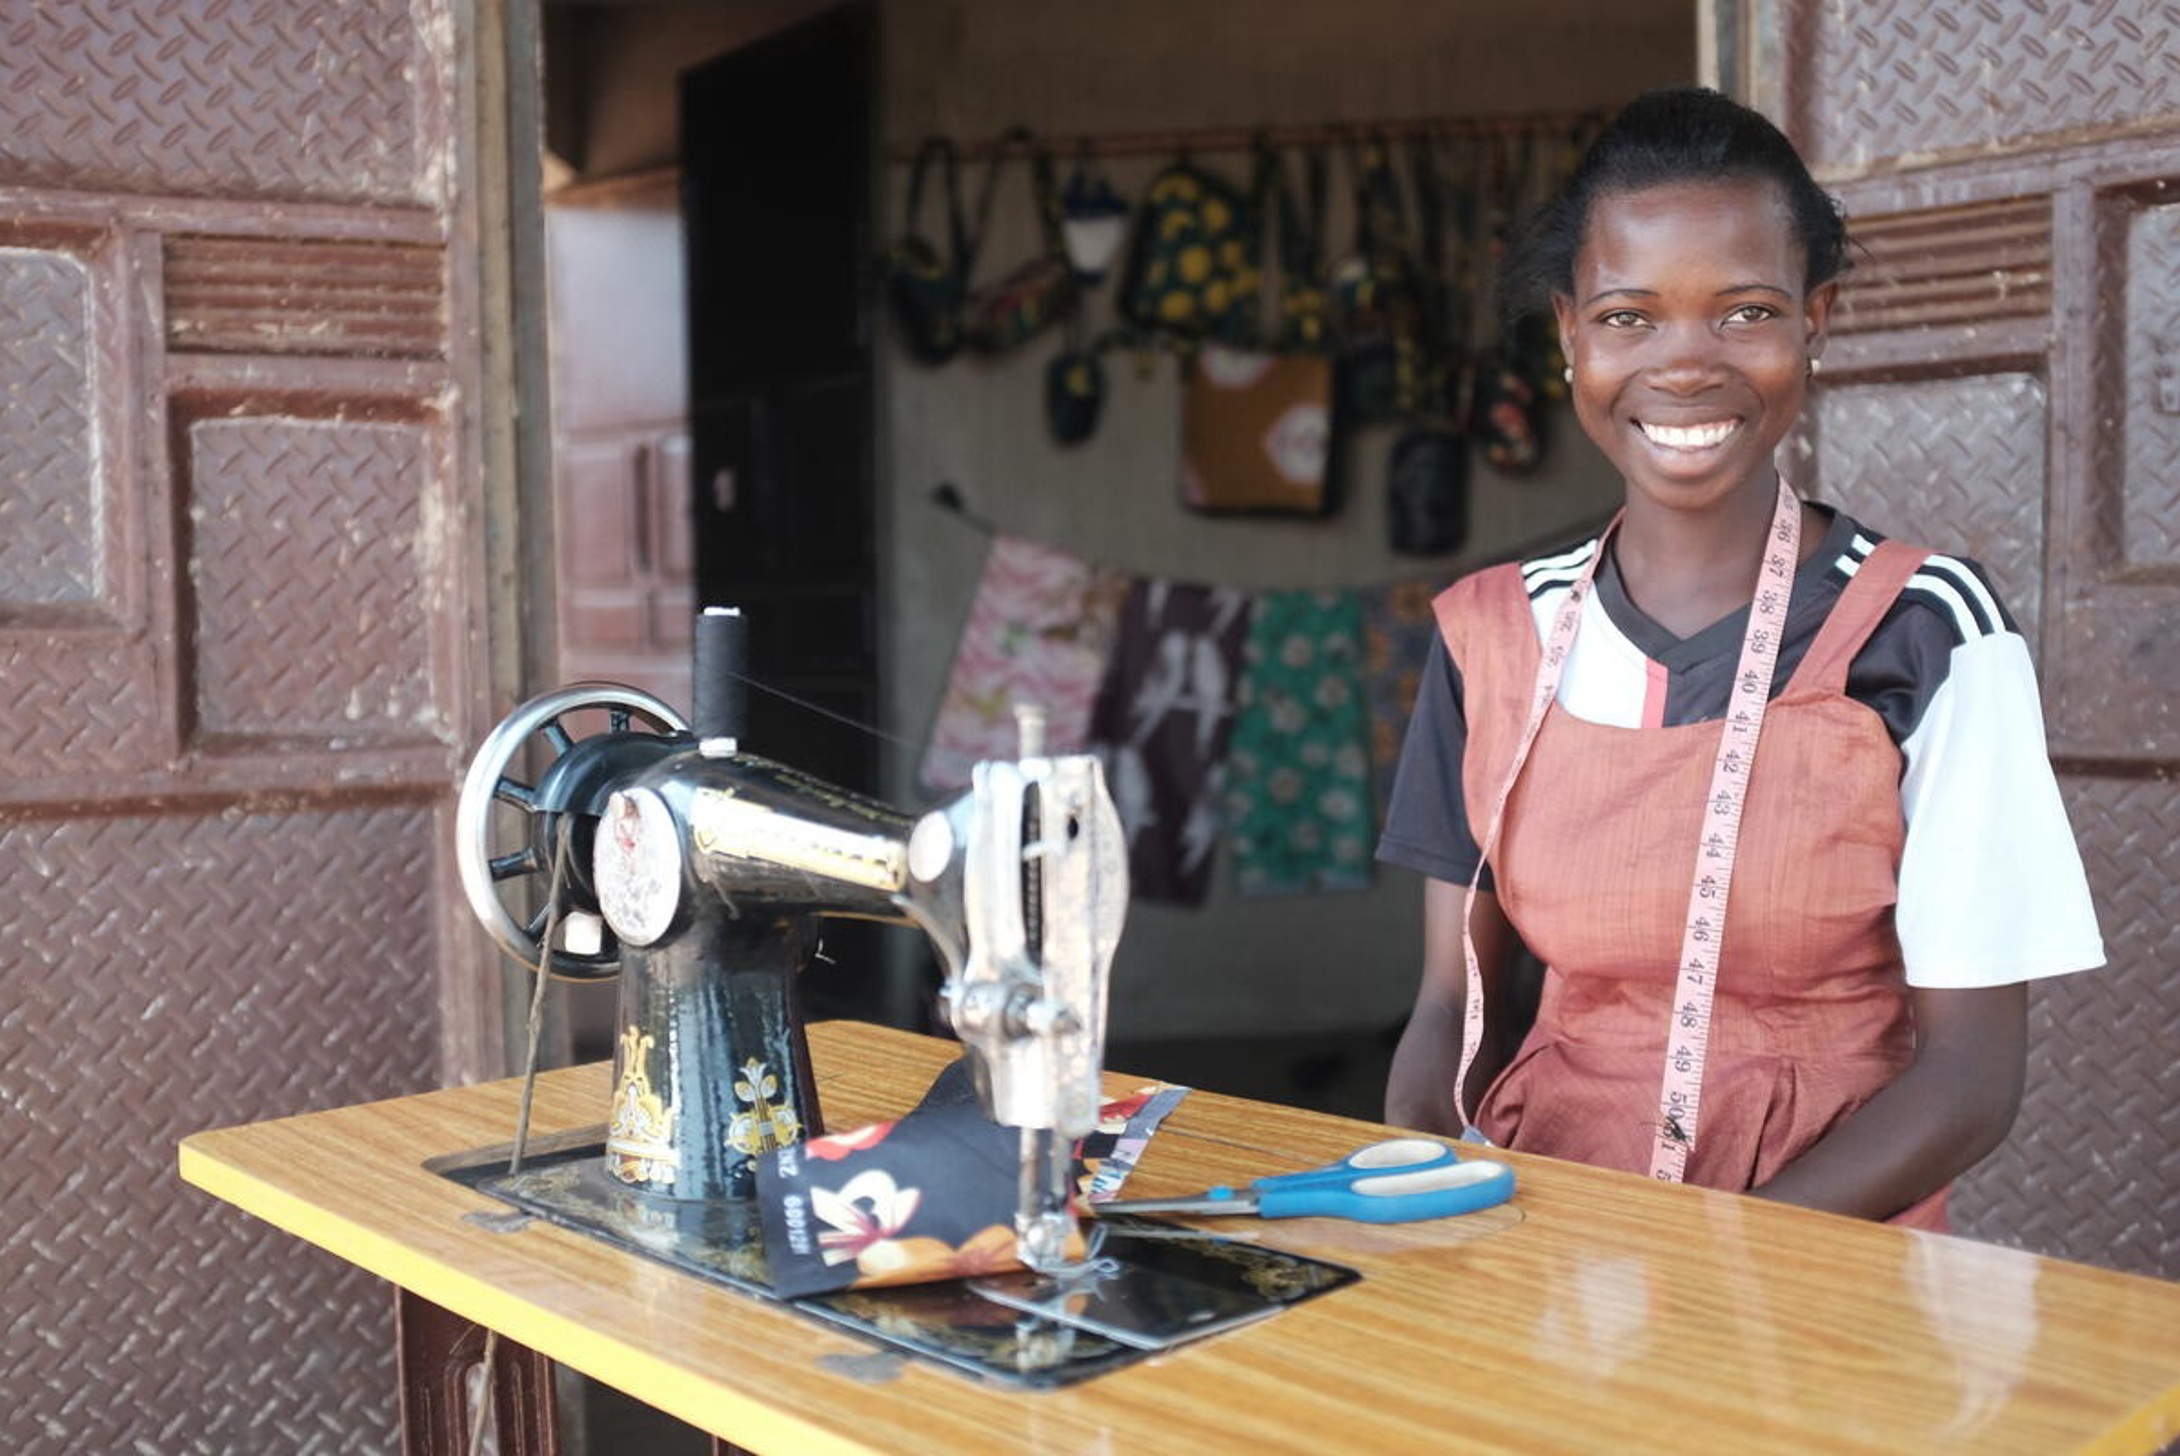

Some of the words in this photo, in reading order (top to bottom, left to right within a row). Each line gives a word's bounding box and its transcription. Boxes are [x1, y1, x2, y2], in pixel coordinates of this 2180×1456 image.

[1777, 519, 1794, 543] 36
[1769, 554, 1787, 578] 37
[1759, 589, 1778, 615] 38
[1750, 629, 1770, 654] 39
[1741, 669, 1760, 694] 40
[1732, 711, 1750, 733] 41
[1722, 749, 1741, 773] 42
[1713, 789, 1732, 815] 43
[1706, 832, 1725, 858] 44
[1699, 875, 1717, 899] 45
[1692, 916, 1711, 942] 46
[1686, 958, 1705, 985] 47
[1680, 1002, 1699, 1028] 48
[1674, 1045, 1694, 1073] 49
[1668, 1091, 1688, 1121] 50
